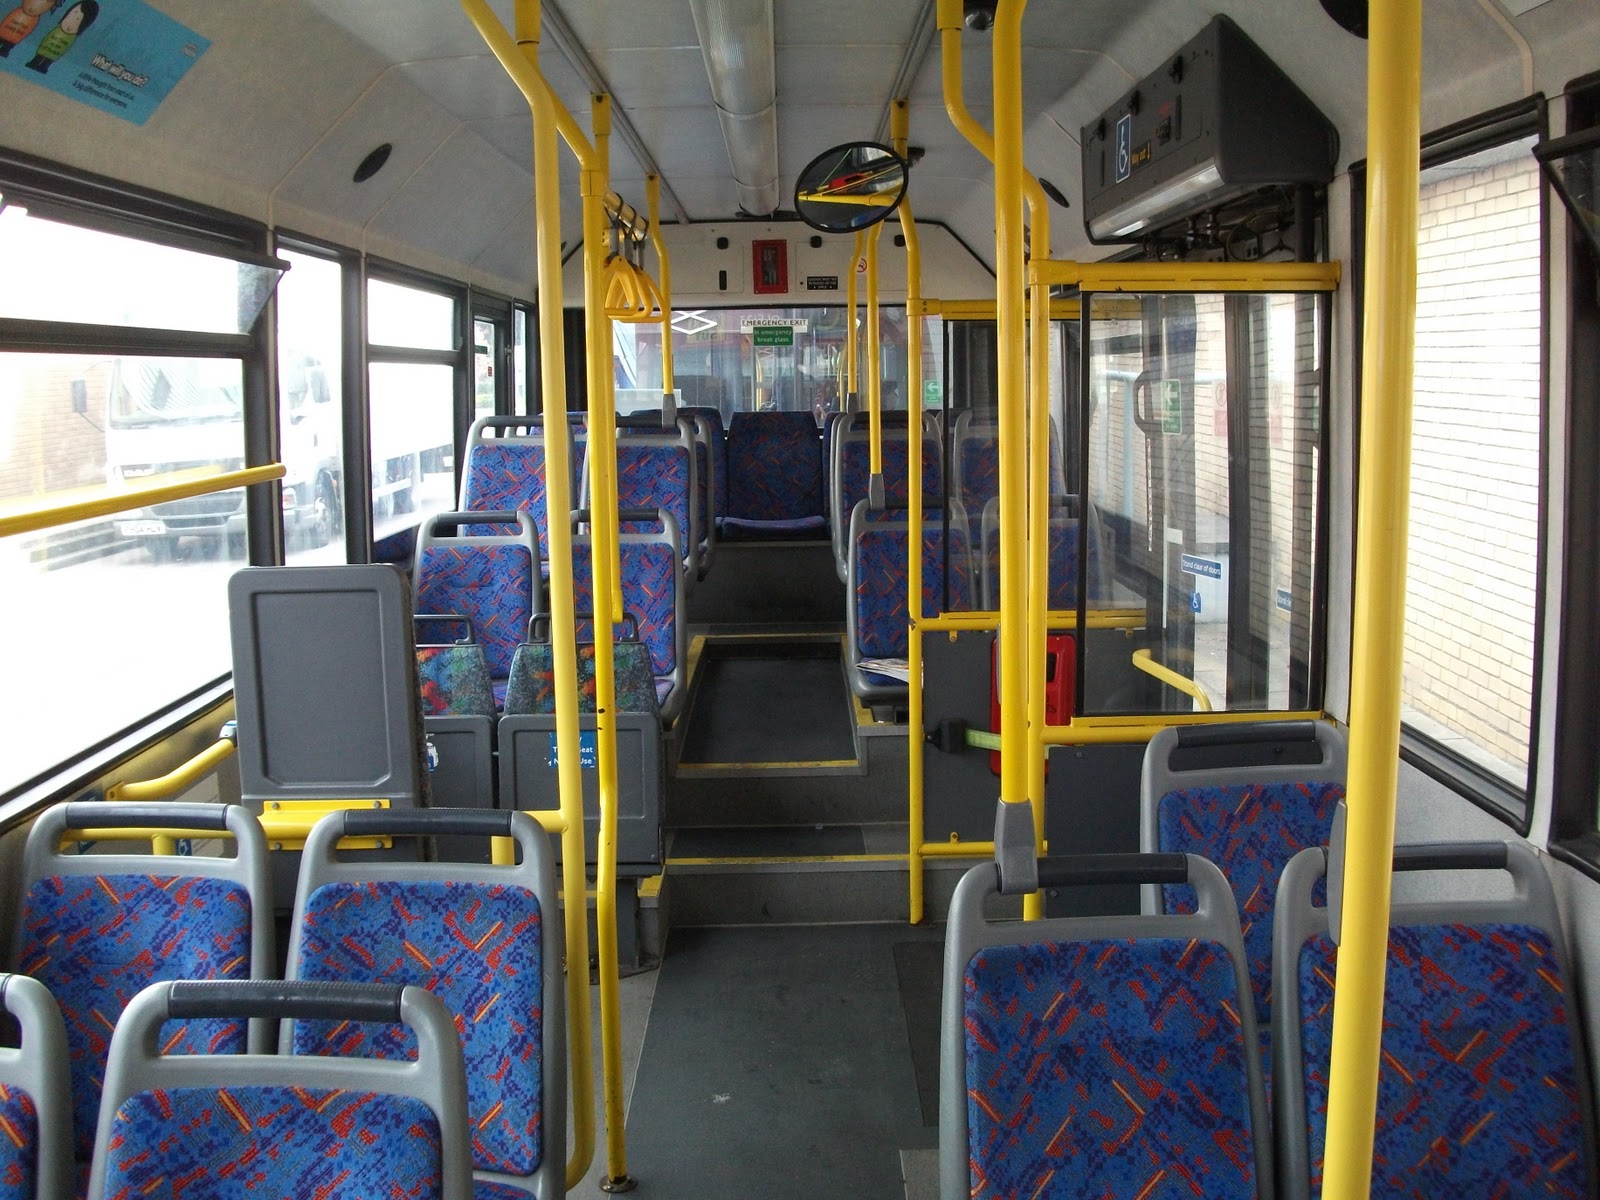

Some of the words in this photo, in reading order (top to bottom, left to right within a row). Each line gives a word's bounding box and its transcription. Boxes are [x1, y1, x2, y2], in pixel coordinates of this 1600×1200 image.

[91, 54, 112, 71] What
[1182, 559, 1193, 568] Stand
[1194, 562, 1203, 571] clear
[1209, 566, 1221, 576] doors
